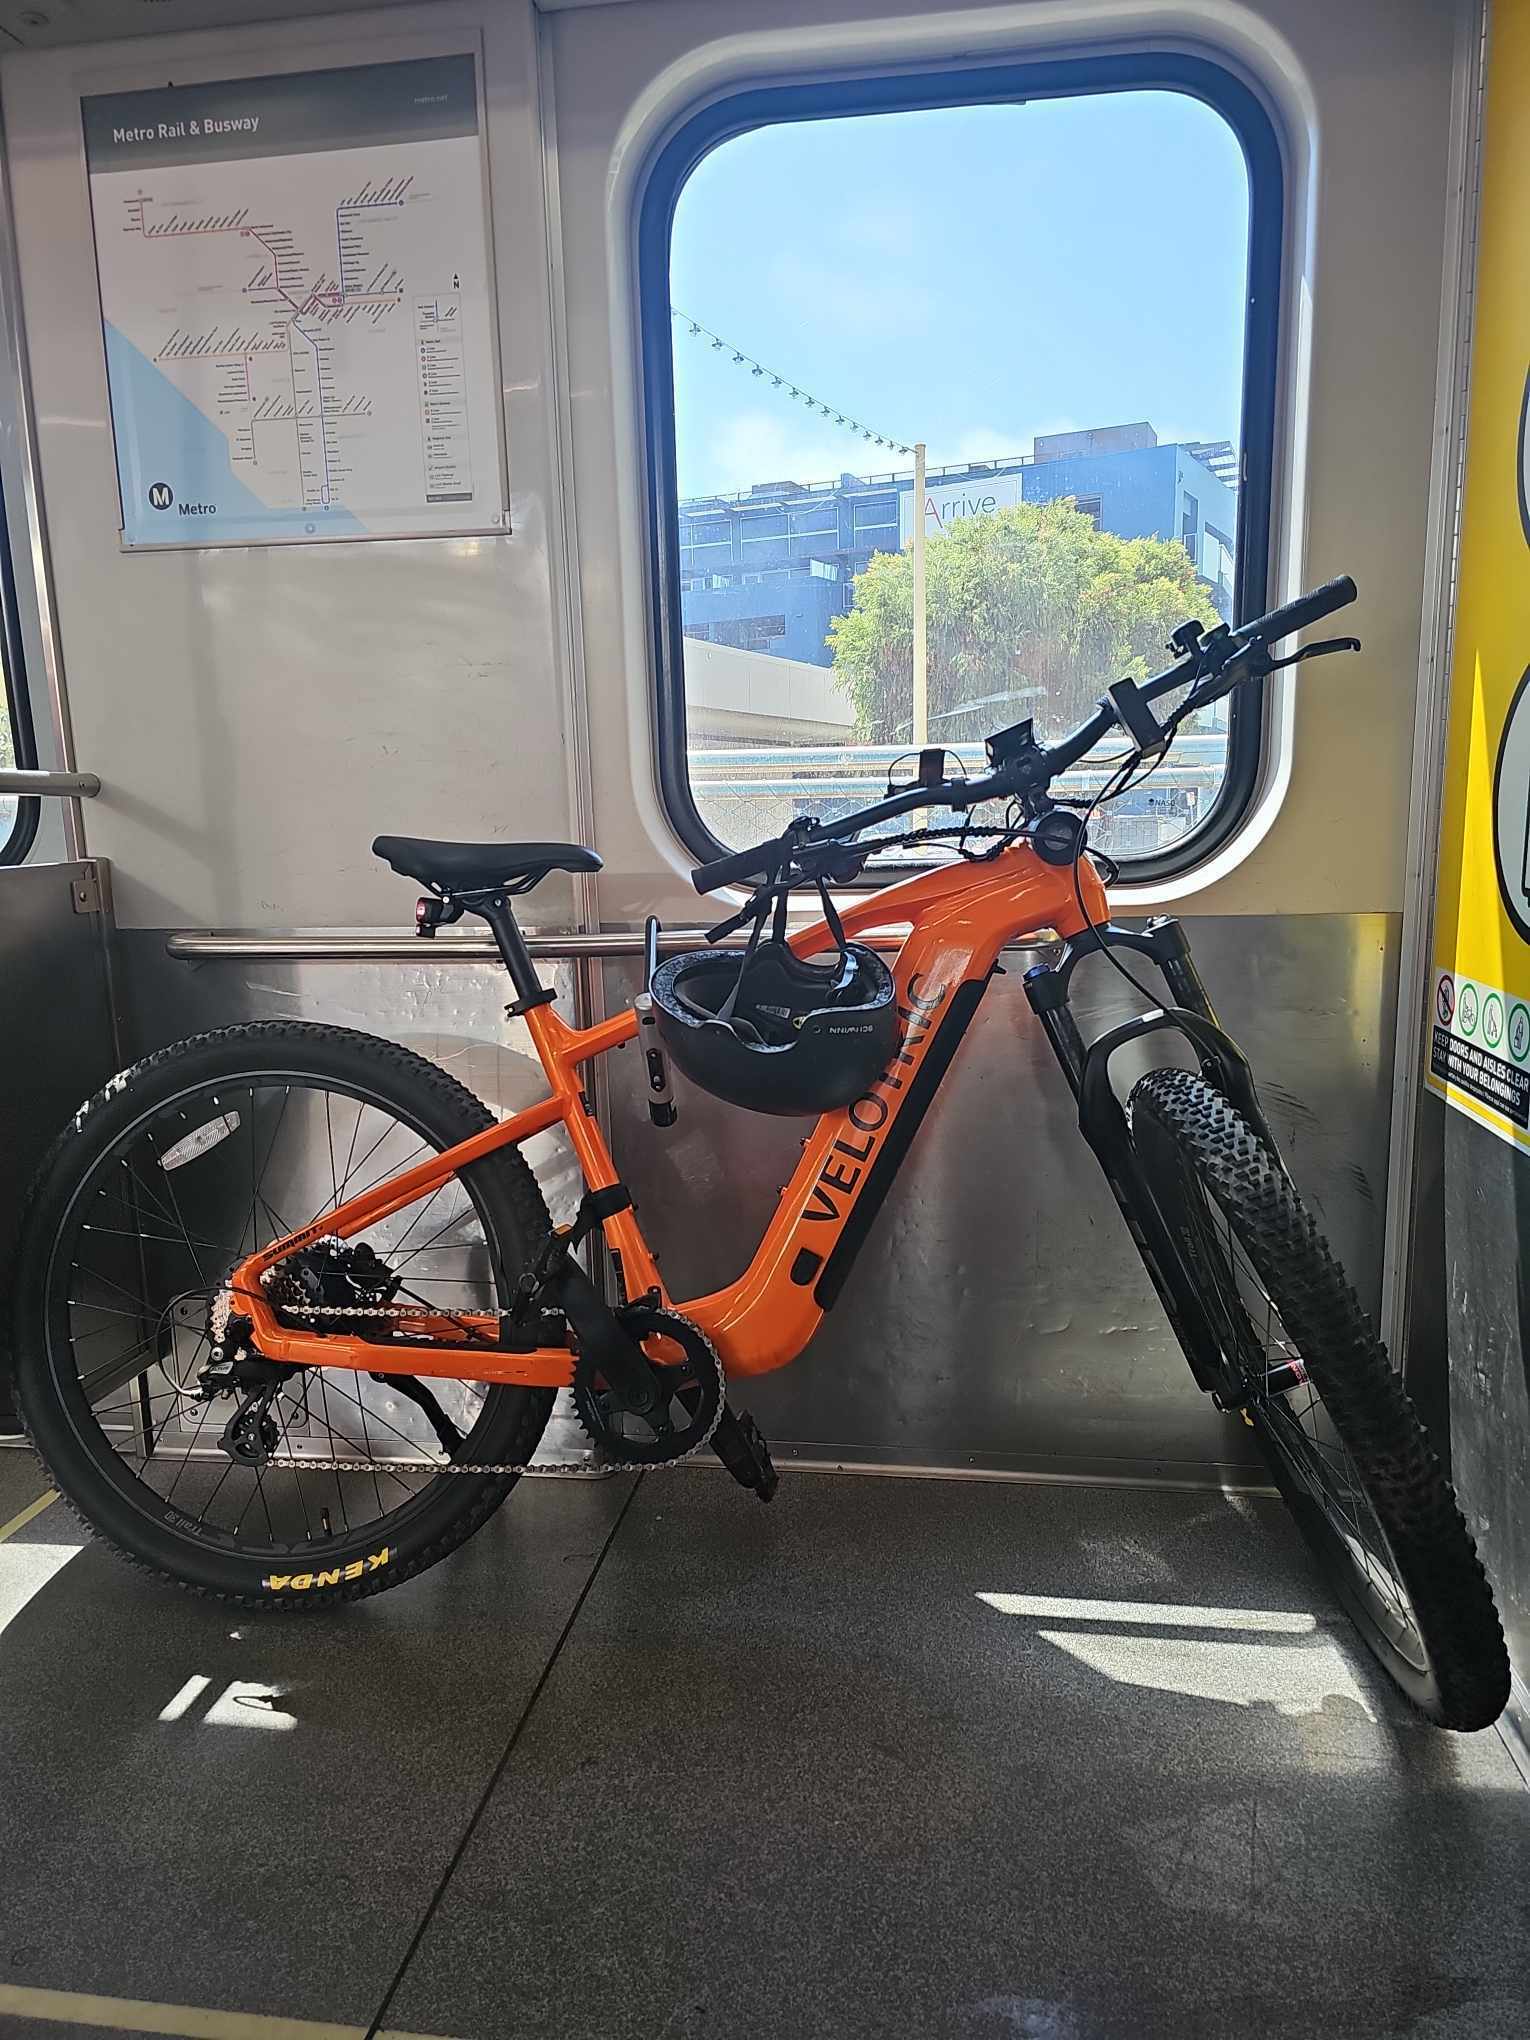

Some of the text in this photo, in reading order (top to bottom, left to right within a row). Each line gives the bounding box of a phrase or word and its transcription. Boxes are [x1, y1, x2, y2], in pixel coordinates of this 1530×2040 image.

[113, 116, 260, 143] Metro Rail & Busway
[152, 487, 170, 506] M
[178, 503, 217, 516] Metro
[925, 492, 996, 529] Arrive
[1433, 1047, 1520, 1106] STAY WITH YOUR BELONGINGS
[1434, 1030, 1529, 1093] KEEP DOORS AND AISLES CLEAR
[269, 1547, 390, 1590] KENDA
